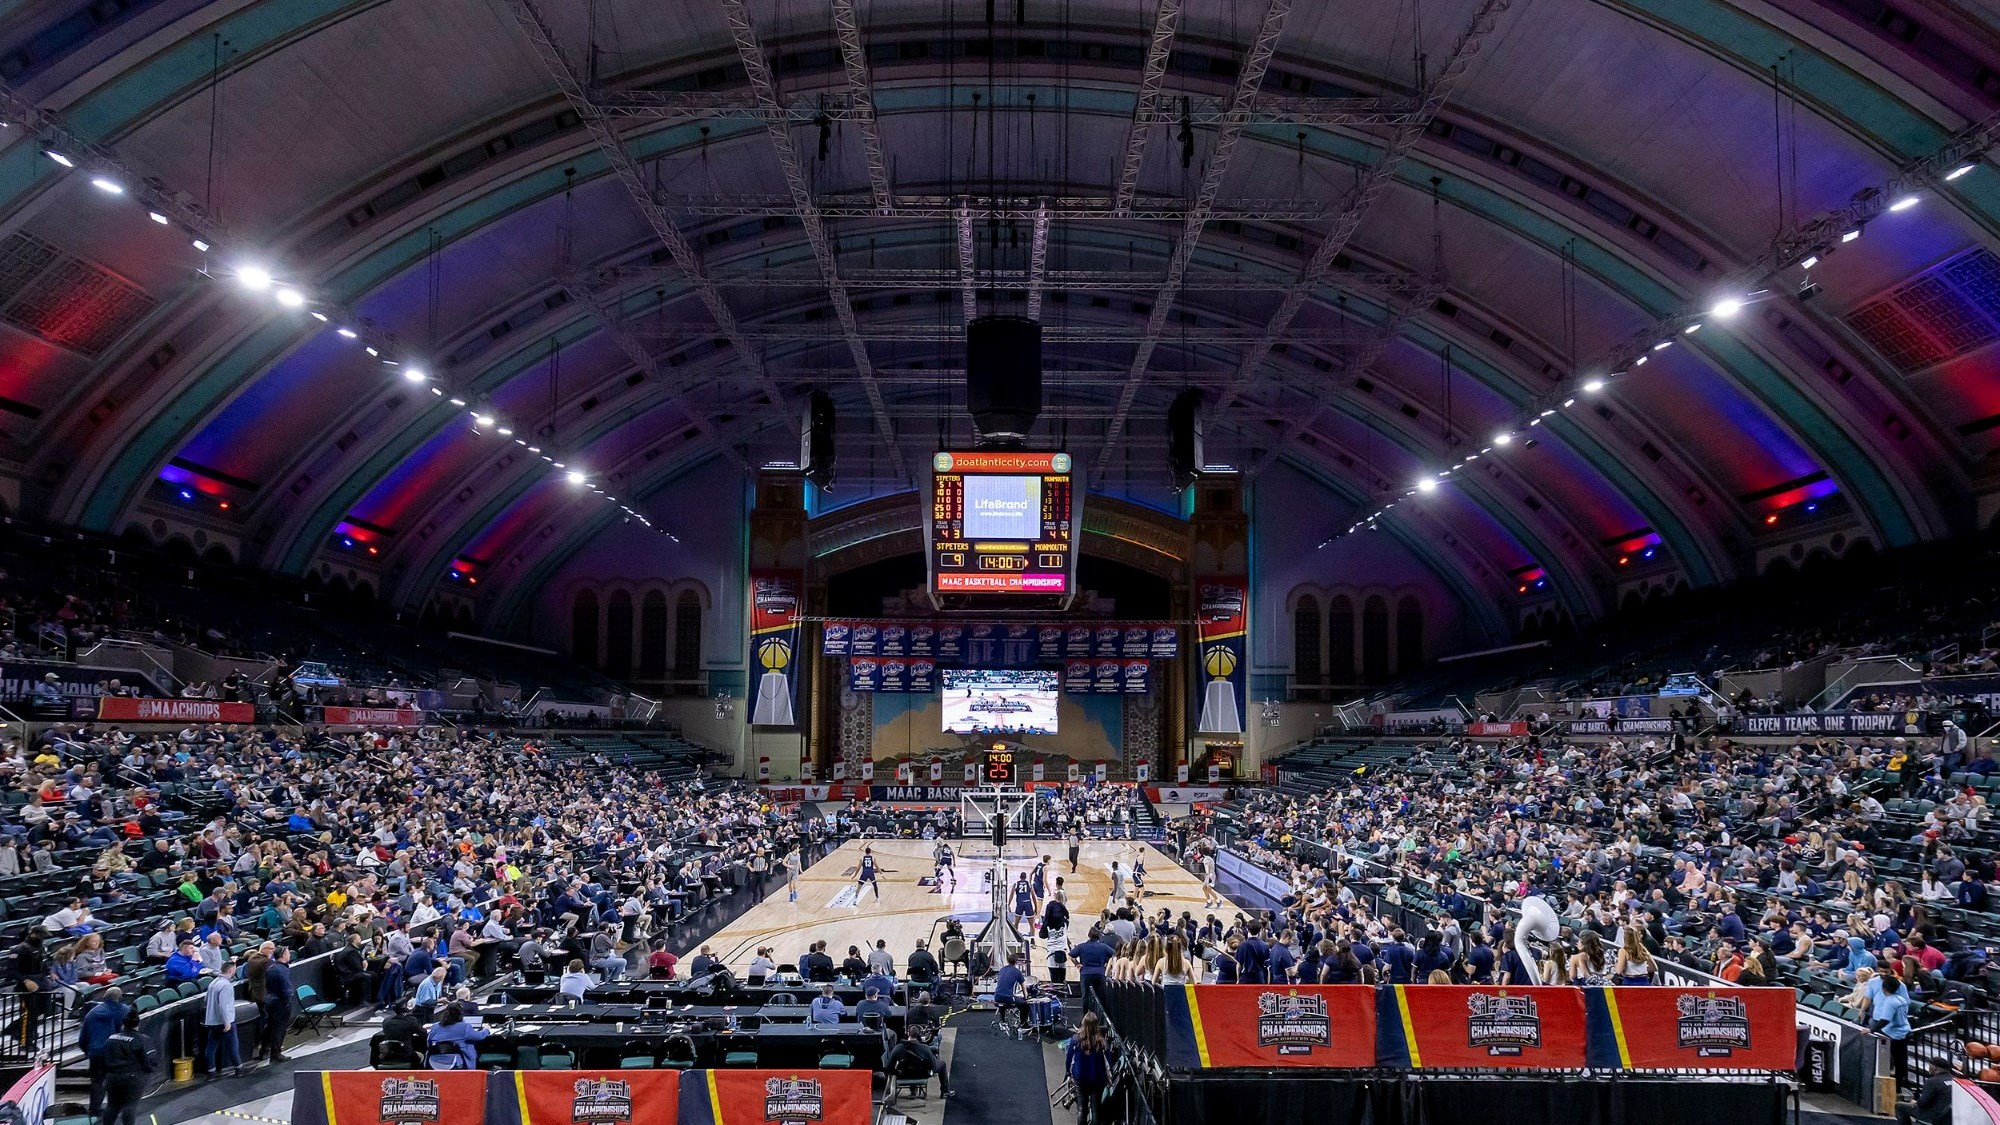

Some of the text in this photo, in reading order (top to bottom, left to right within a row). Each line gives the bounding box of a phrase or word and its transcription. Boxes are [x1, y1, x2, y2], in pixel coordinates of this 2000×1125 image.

[956, 458, 1049, 468] doatlanticcity.com
[975, 499, 1028, 510] LifeBrand
[942, 530, 948, 538] 4
[954, 530, 960, 538] 3
[1050, 530, 1056, 539] 4
[1061, 530, 1068, 540] 4
[1035, 544, 1068, 552] MONMOUTH
[954, 554, 962, 566] 9
[984, 556, 1012, 568] 14:00
[1050, 555, 1060, 566] 11
[942, 578, 1062, 587] MAAC BASKETBALL CHAMPIONSHIPS
[138, 701, 220, 719] #MAACHOOPS
[1572, 722, 1586, 732] MAAC
[1750, 715, 1896, 732] ELEVEN TEAMS. ONE TROPHY.
[989, 754, 1012, 762] 14:00
[990, 763, 1008, 778] 25
[886, 787, 922, 800] MAAC
[864, 860, 872, 868] 13
[1019, 884, 1028, 893] 21
[1262, 1025, 1326, 1038] CHAMPIONSHIPS
[1472, 1026, 1537, 1039] CHAMPIONSHIPS
[1680, 1027, 1746, 1040] CHAMPIONSHIPS
[1812, 1046, 1822, 1083] READY
[383, 1104, 436, 1115] CHAMPIONSHIPS
[575, 1106, 629, 1116] CHAMPIONSHIPS
[768, 1104, 820, 1114] CHAMPIONSHIPS
